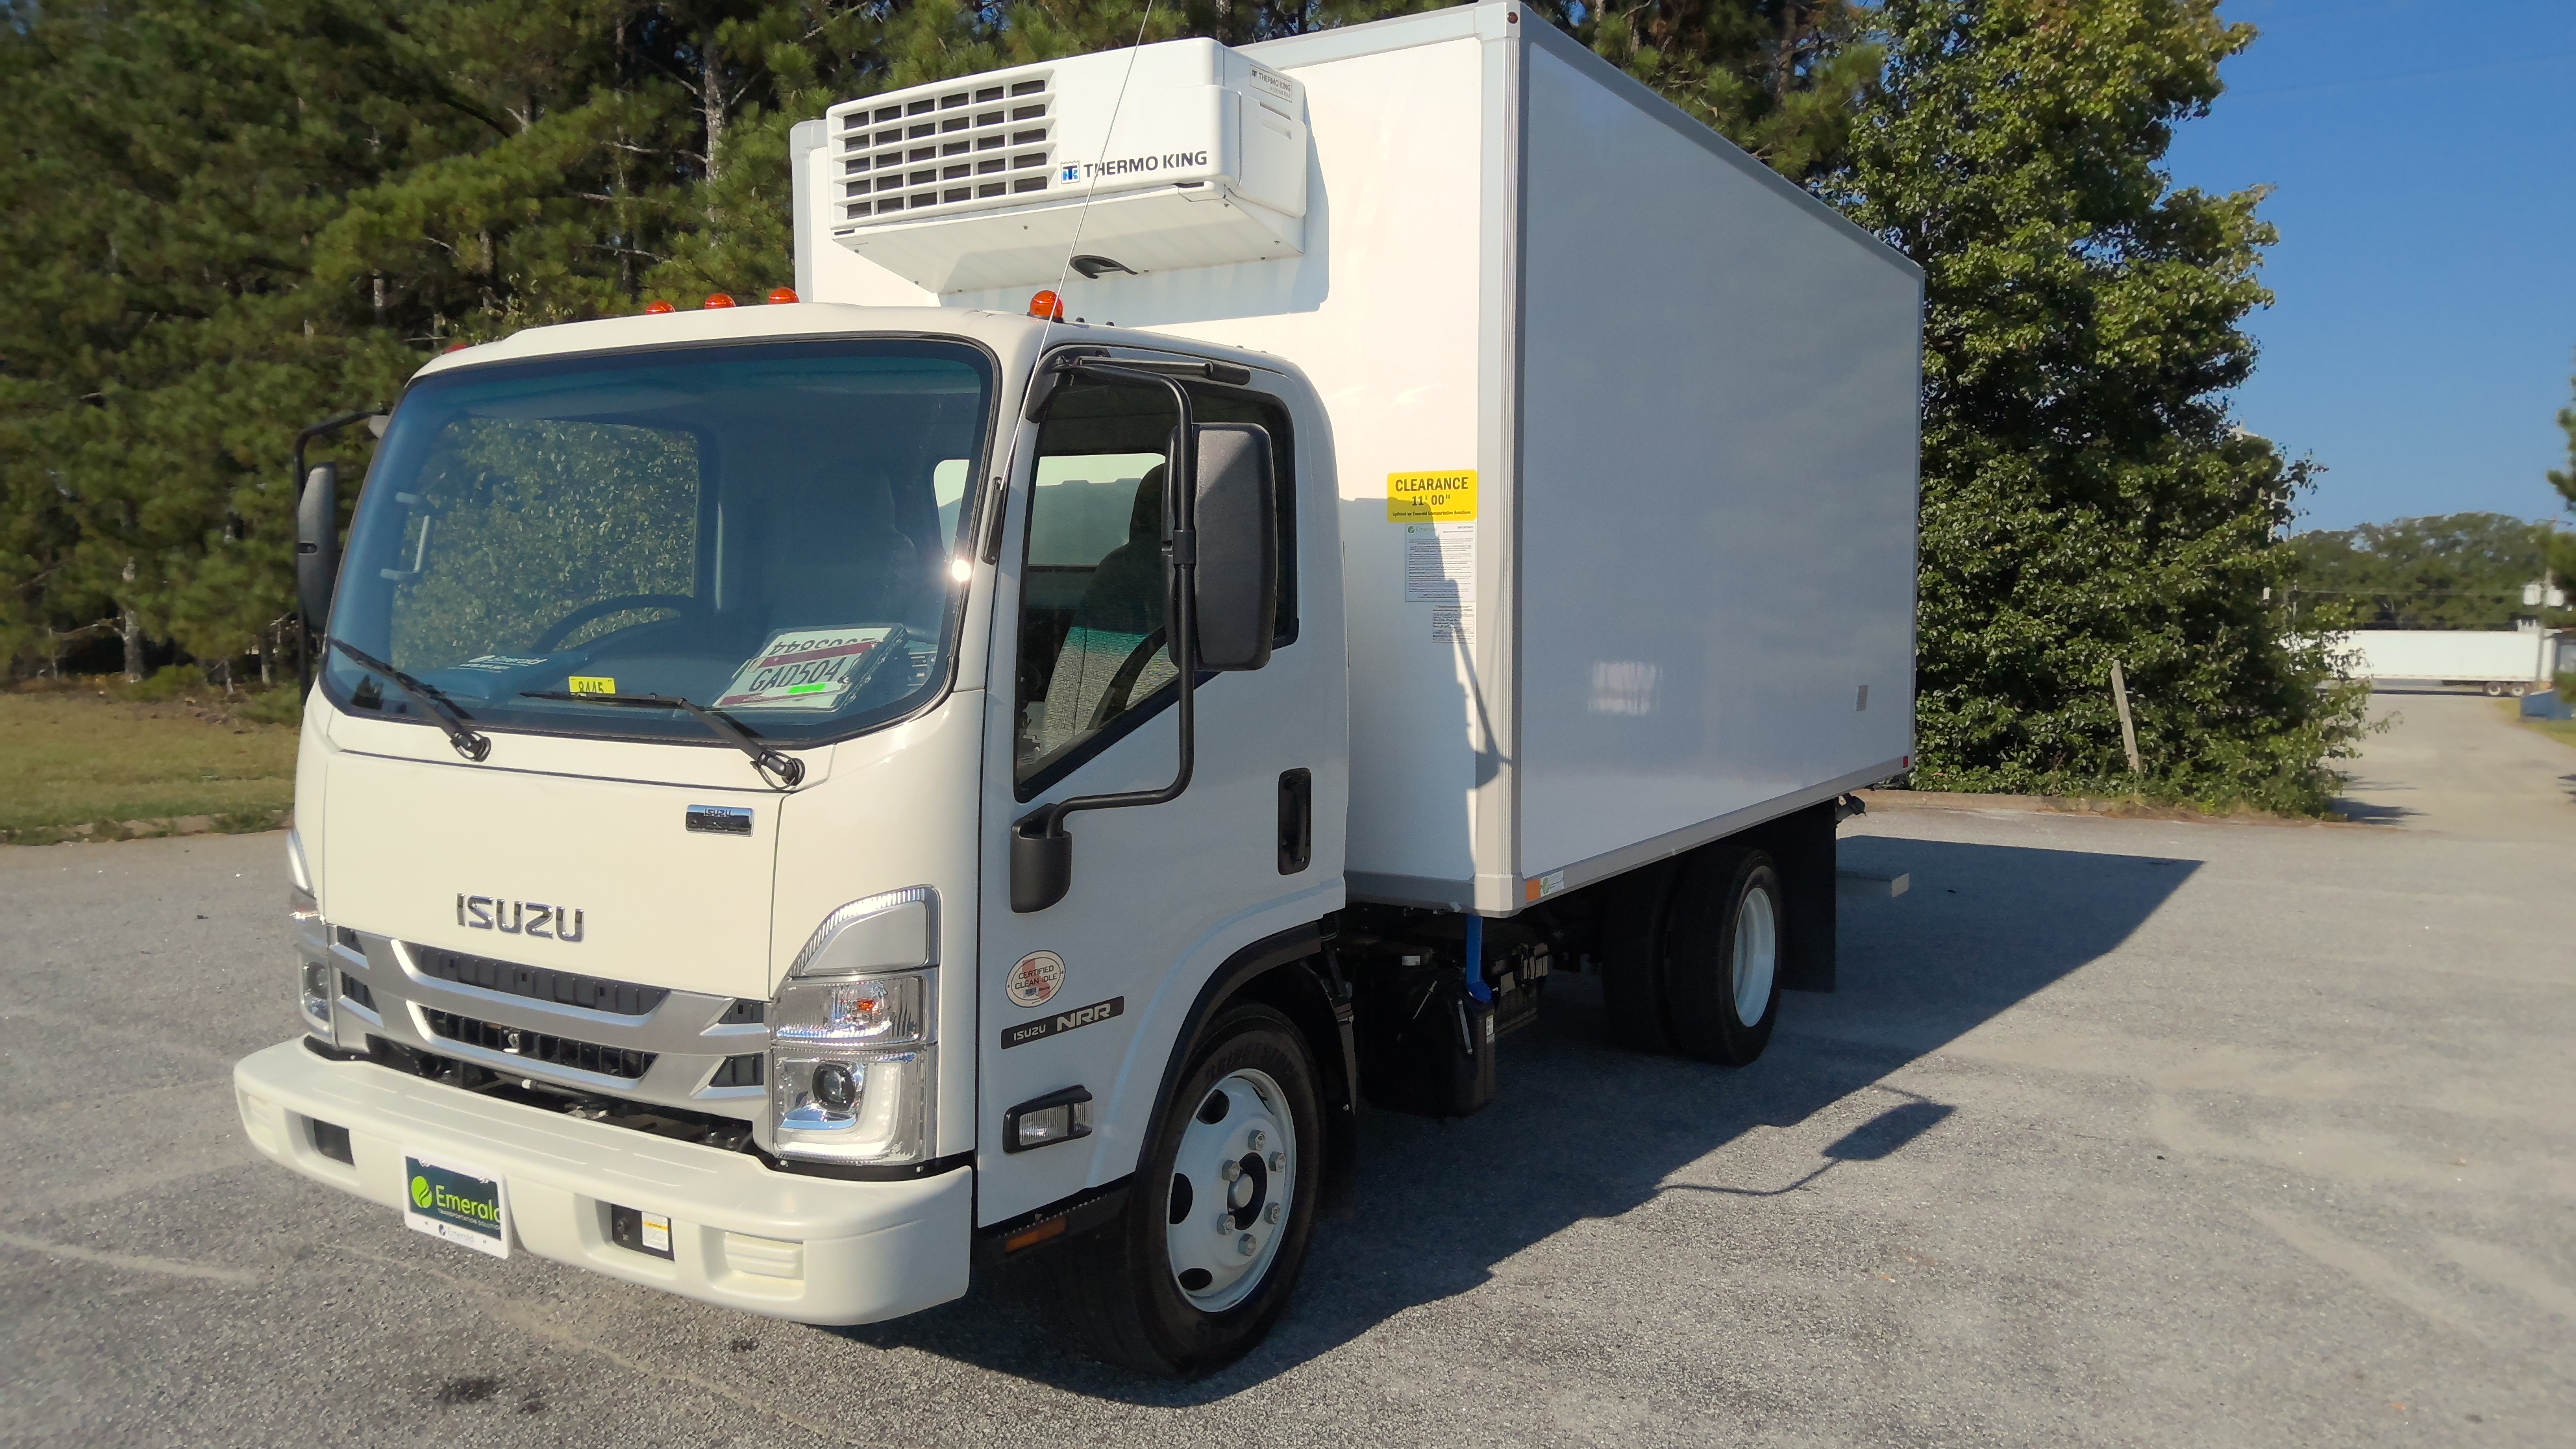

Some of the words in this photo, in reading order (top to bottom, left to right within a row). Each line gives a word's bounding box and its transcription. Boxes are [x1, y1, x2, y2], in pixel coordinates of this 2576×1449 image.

[1259, 71, 1279, 87] THERMO
[1280, 80, 1291, 92] KING
[1084, 156, 1158, 178] THERMO
[1163, 151, 1208, 169] KING
[1395, 477, 1469, 492] CLEARANCE
[704, 808, 732, 818] ISUZU
[456, 893, 585, 943] ISUZU
[1014, 978, 1039, 990] CLEAN
[1042, 973, 1058, 983] IDLE
[1018, 965, 1054, 980] CERTIFIED
[1013, 1024, 1046, 1041] ISUZU
[1056, 1003, 1111, 1032] NRR
